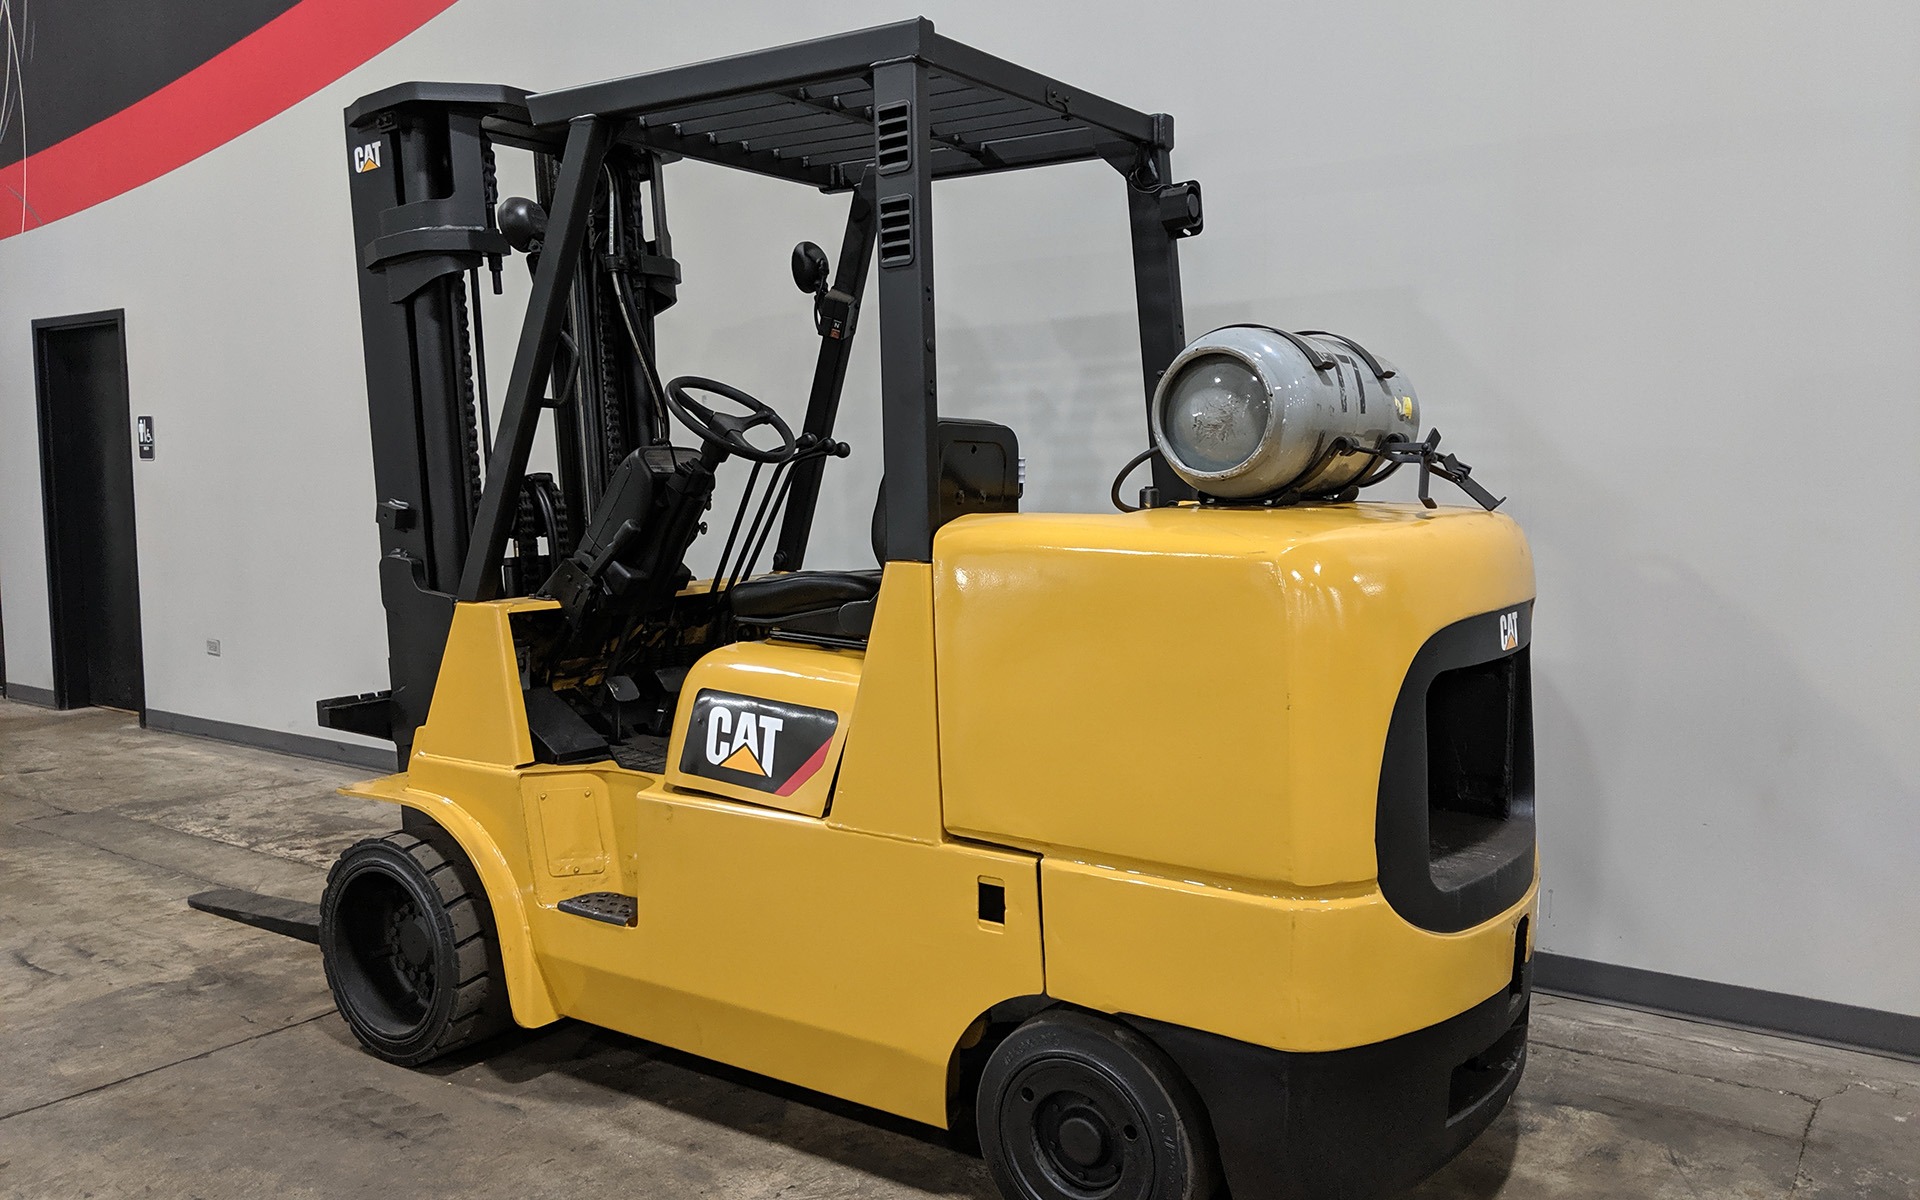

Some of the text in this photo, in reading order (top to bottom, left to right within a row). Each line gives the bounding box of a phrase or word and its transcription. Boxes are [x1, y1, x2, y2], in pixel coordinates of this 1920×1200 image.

[354, 141, 381, 173] CAT
[1500, 611, 1518, 651] CAT
[706, 706, 784, 778] CAT
